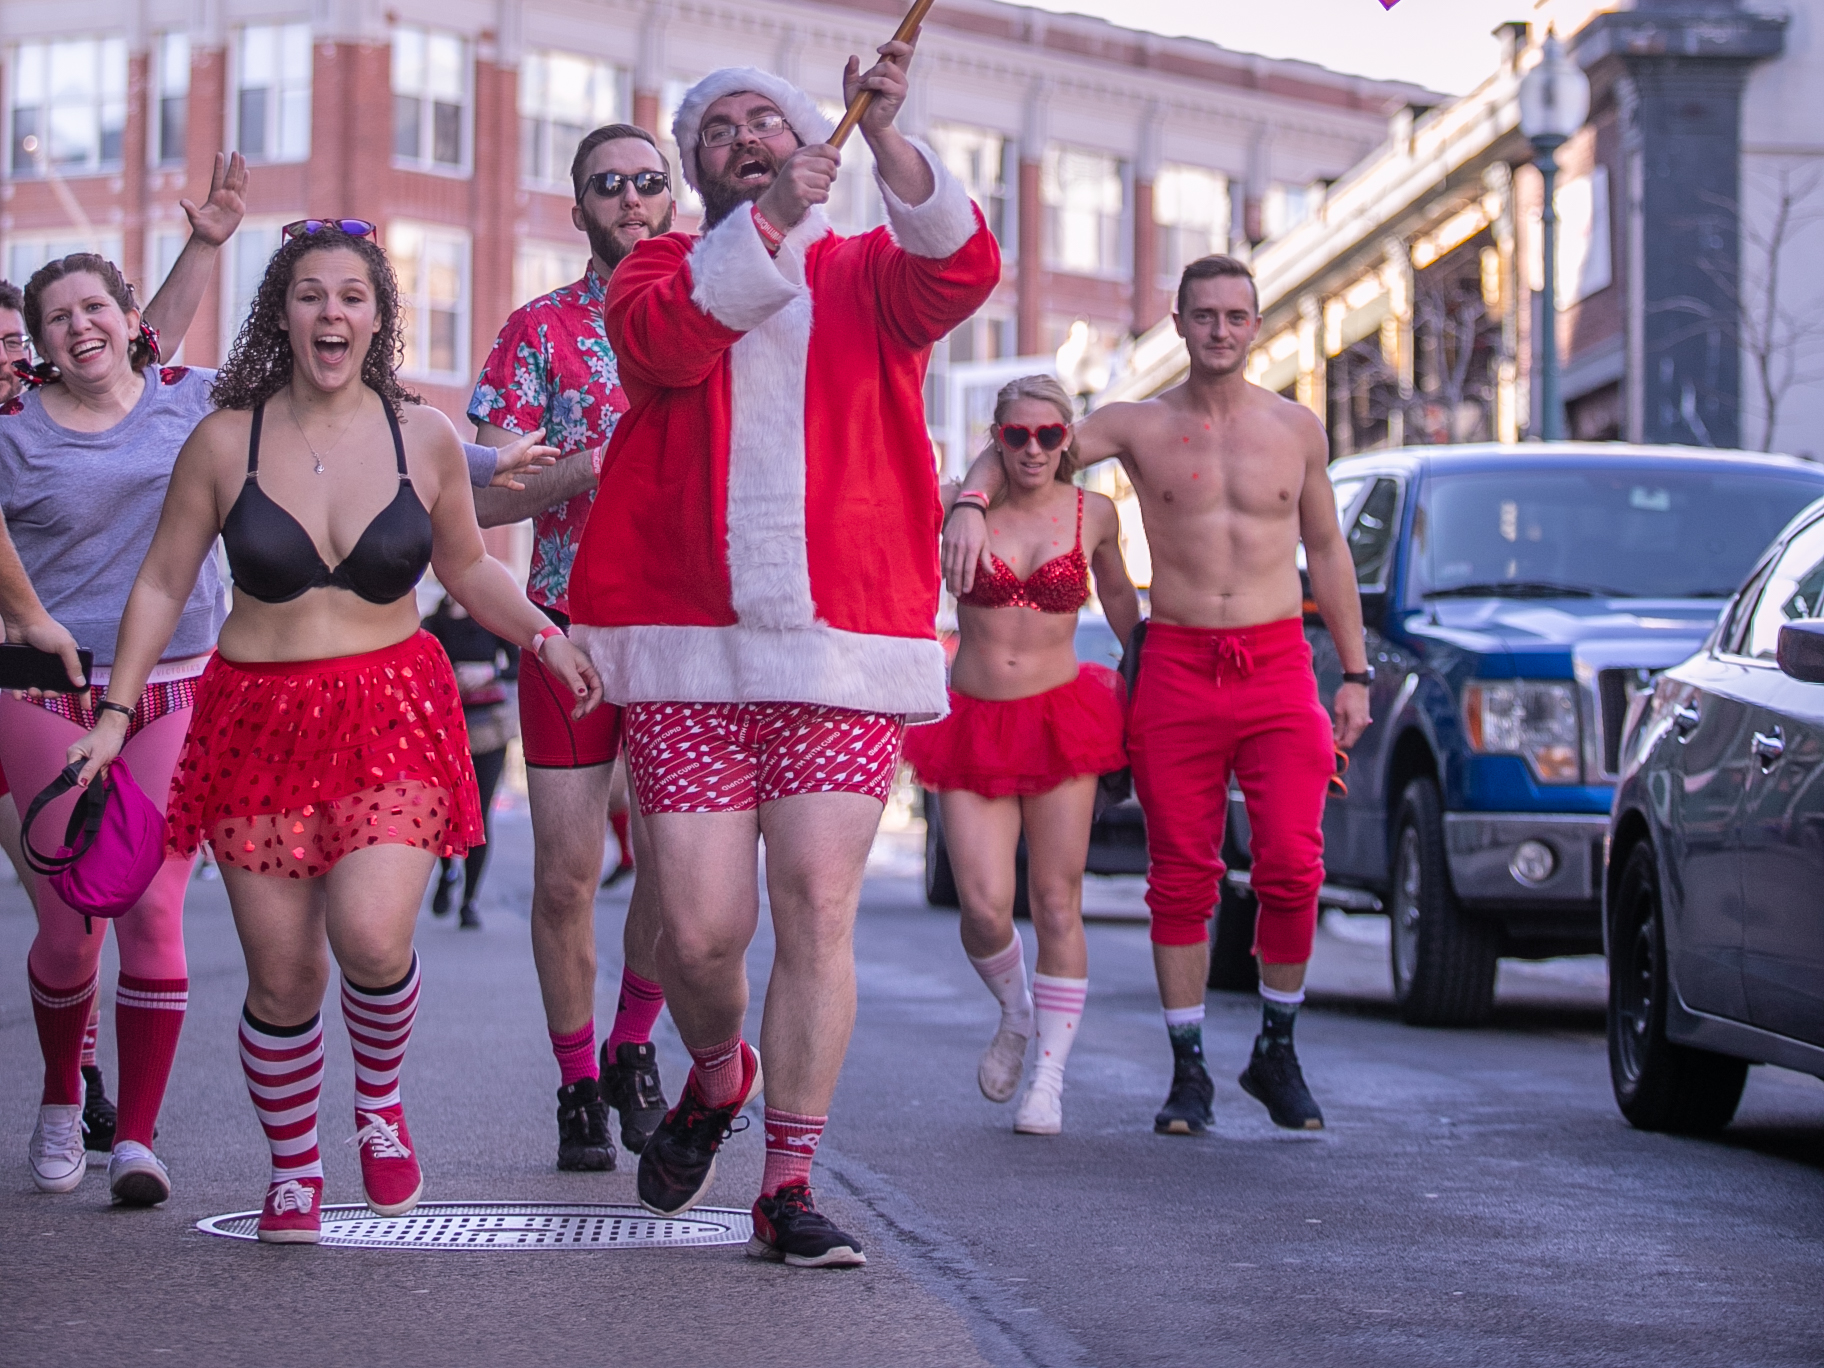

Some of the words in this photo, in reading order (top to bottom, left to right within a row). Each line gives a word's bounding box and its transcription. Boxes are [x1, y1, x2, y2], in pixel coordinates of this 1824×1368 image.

[156, 664, 201, 677] VICTORIA'S
[649, 736, 662, 750] WITH
[661, 726, 682, 739] CUPID
[880, 730, 892, 744] WITH
[794, 759, 807, 770] I'M
[803, 745, 824, 761] WITH
[820, 731, 841, 747] CUPID
[868, 741, 883, 756] CUPID
[660, 772, 679, 786] WITH
[677, 762, 700, 775] CUPID
[760, 765, 771, 782] WITH
[721, 777, 745, 791] CUPID
